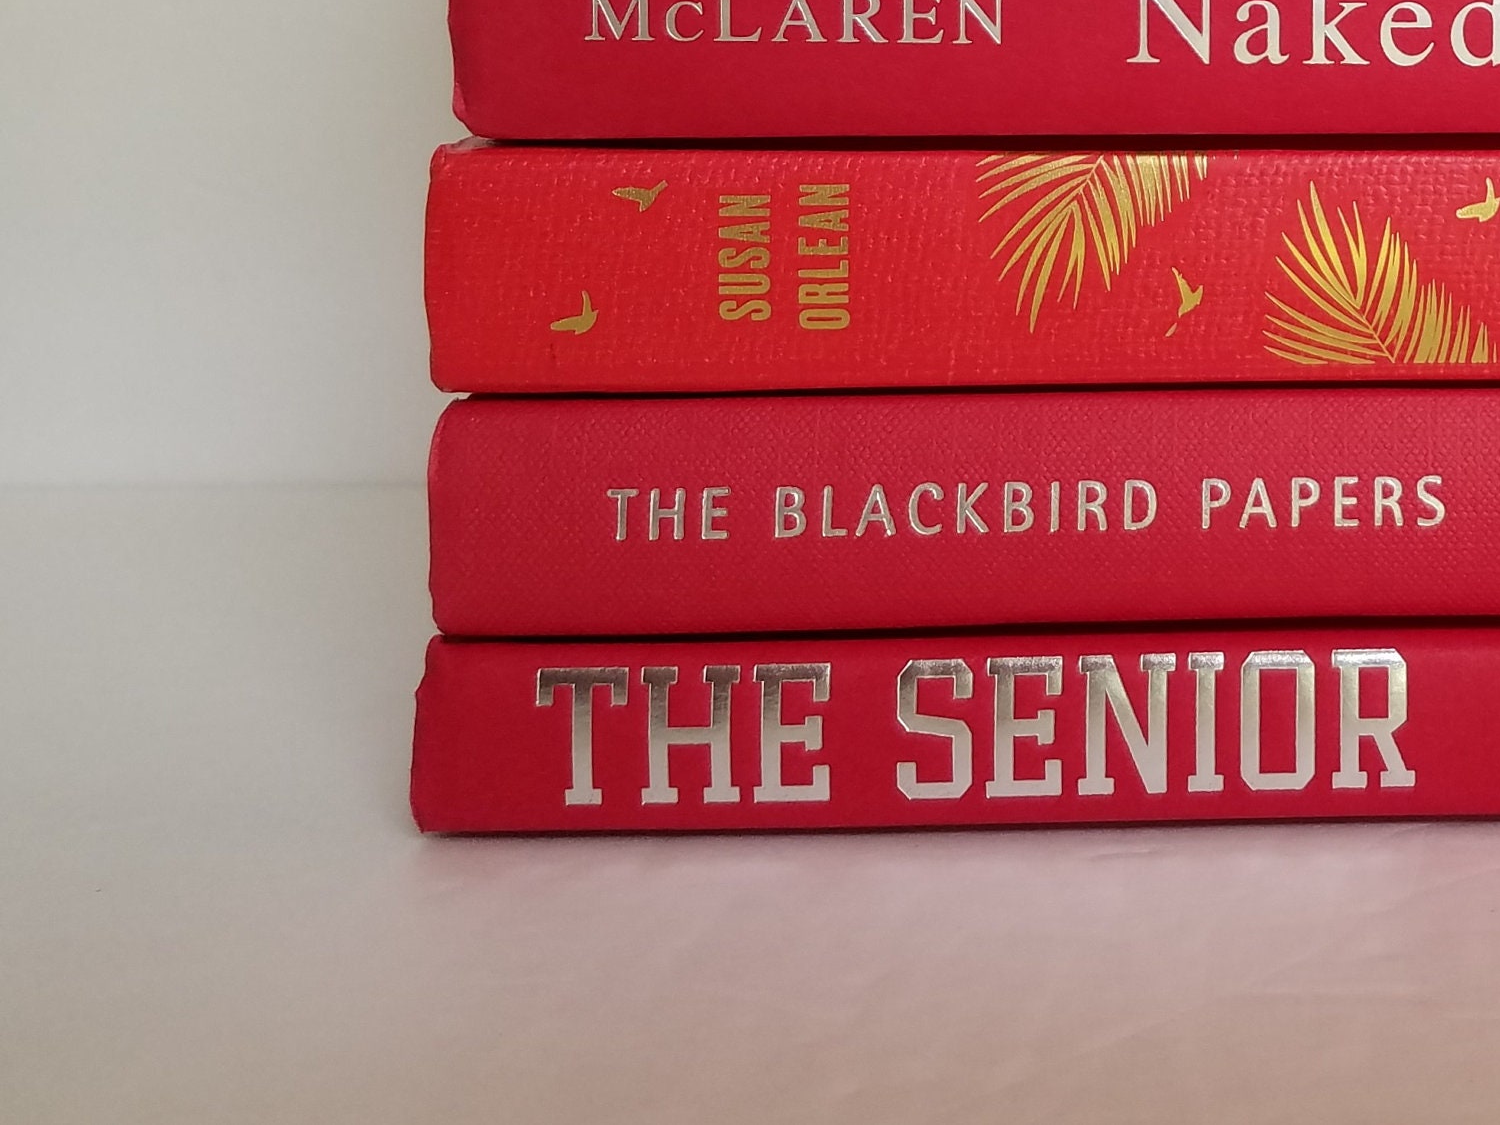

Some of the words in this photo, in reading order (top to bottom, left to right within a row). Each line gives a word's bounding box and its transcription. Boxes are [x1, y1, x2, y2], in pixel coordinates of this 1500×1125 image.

[718, 194, 771, 321] SUSAN
[797, 183, 851, 330] ORLEAN
[606, 486, 731, 541] THE
[773, 480, 1157, 538] BLACKBIRD
[1201, 475, 1447, 529] PAPERS
[534, 662, 831, 806] THE
[895, 648, 1416, 802] SENIOR
